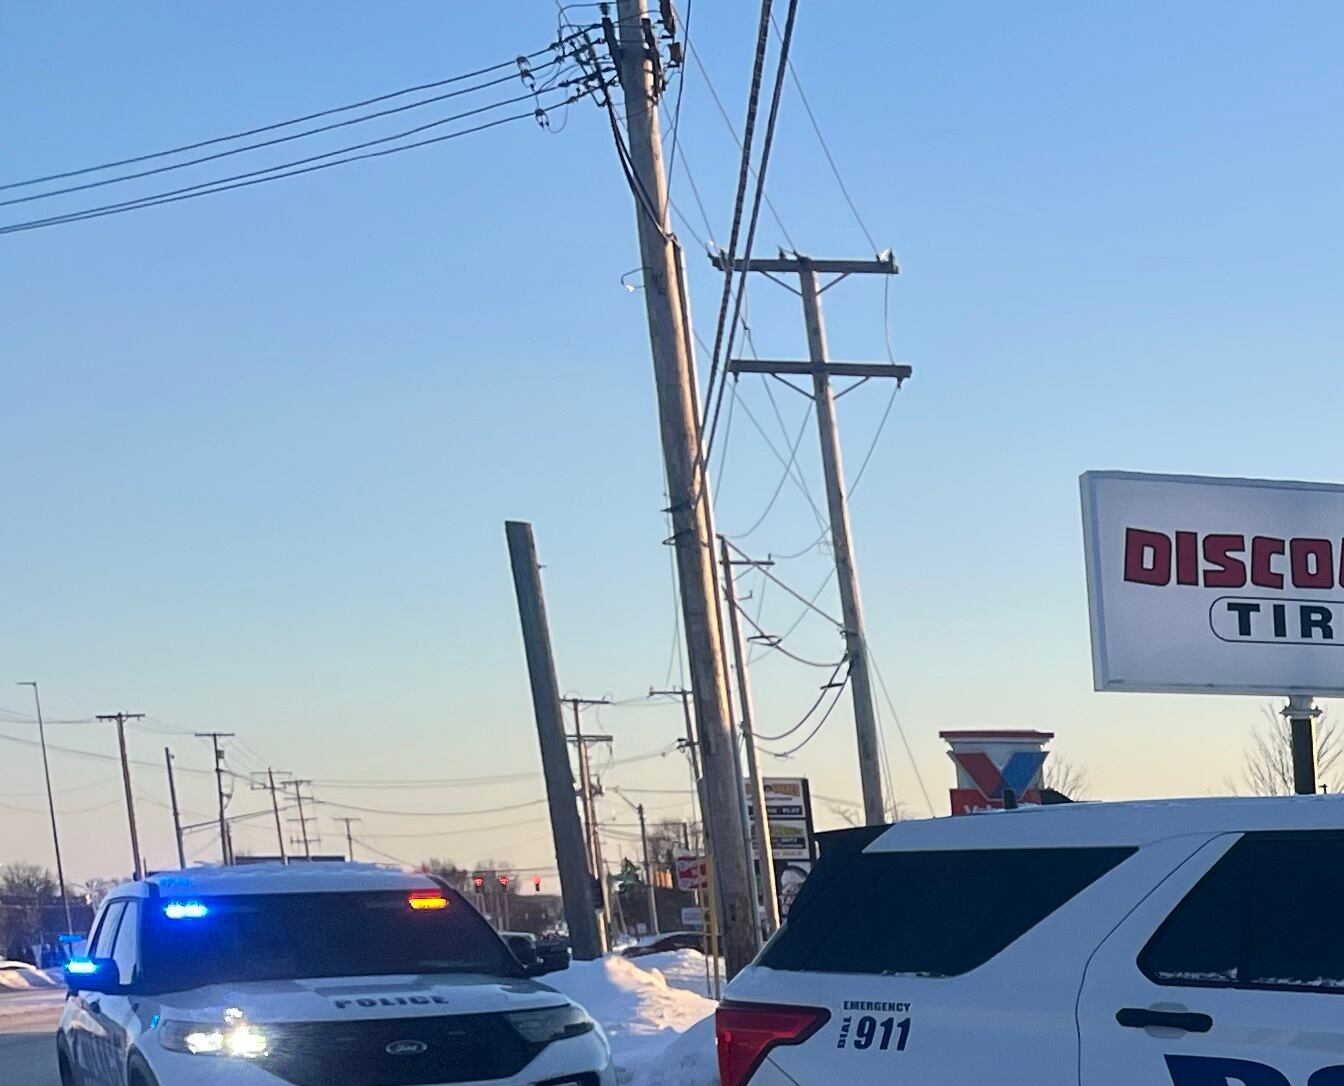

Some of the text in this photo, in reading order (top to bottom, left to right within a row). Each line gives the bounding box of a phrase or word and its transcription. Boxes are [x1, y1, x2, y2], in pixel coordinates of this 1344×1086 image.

[334, 995, 449, 1009] POLICE
[843, 1001, 911, 1012] EMERGENCY
[837, 1016, 852, 1049] DIAL
[854, 1016, 911, 1051] 911
